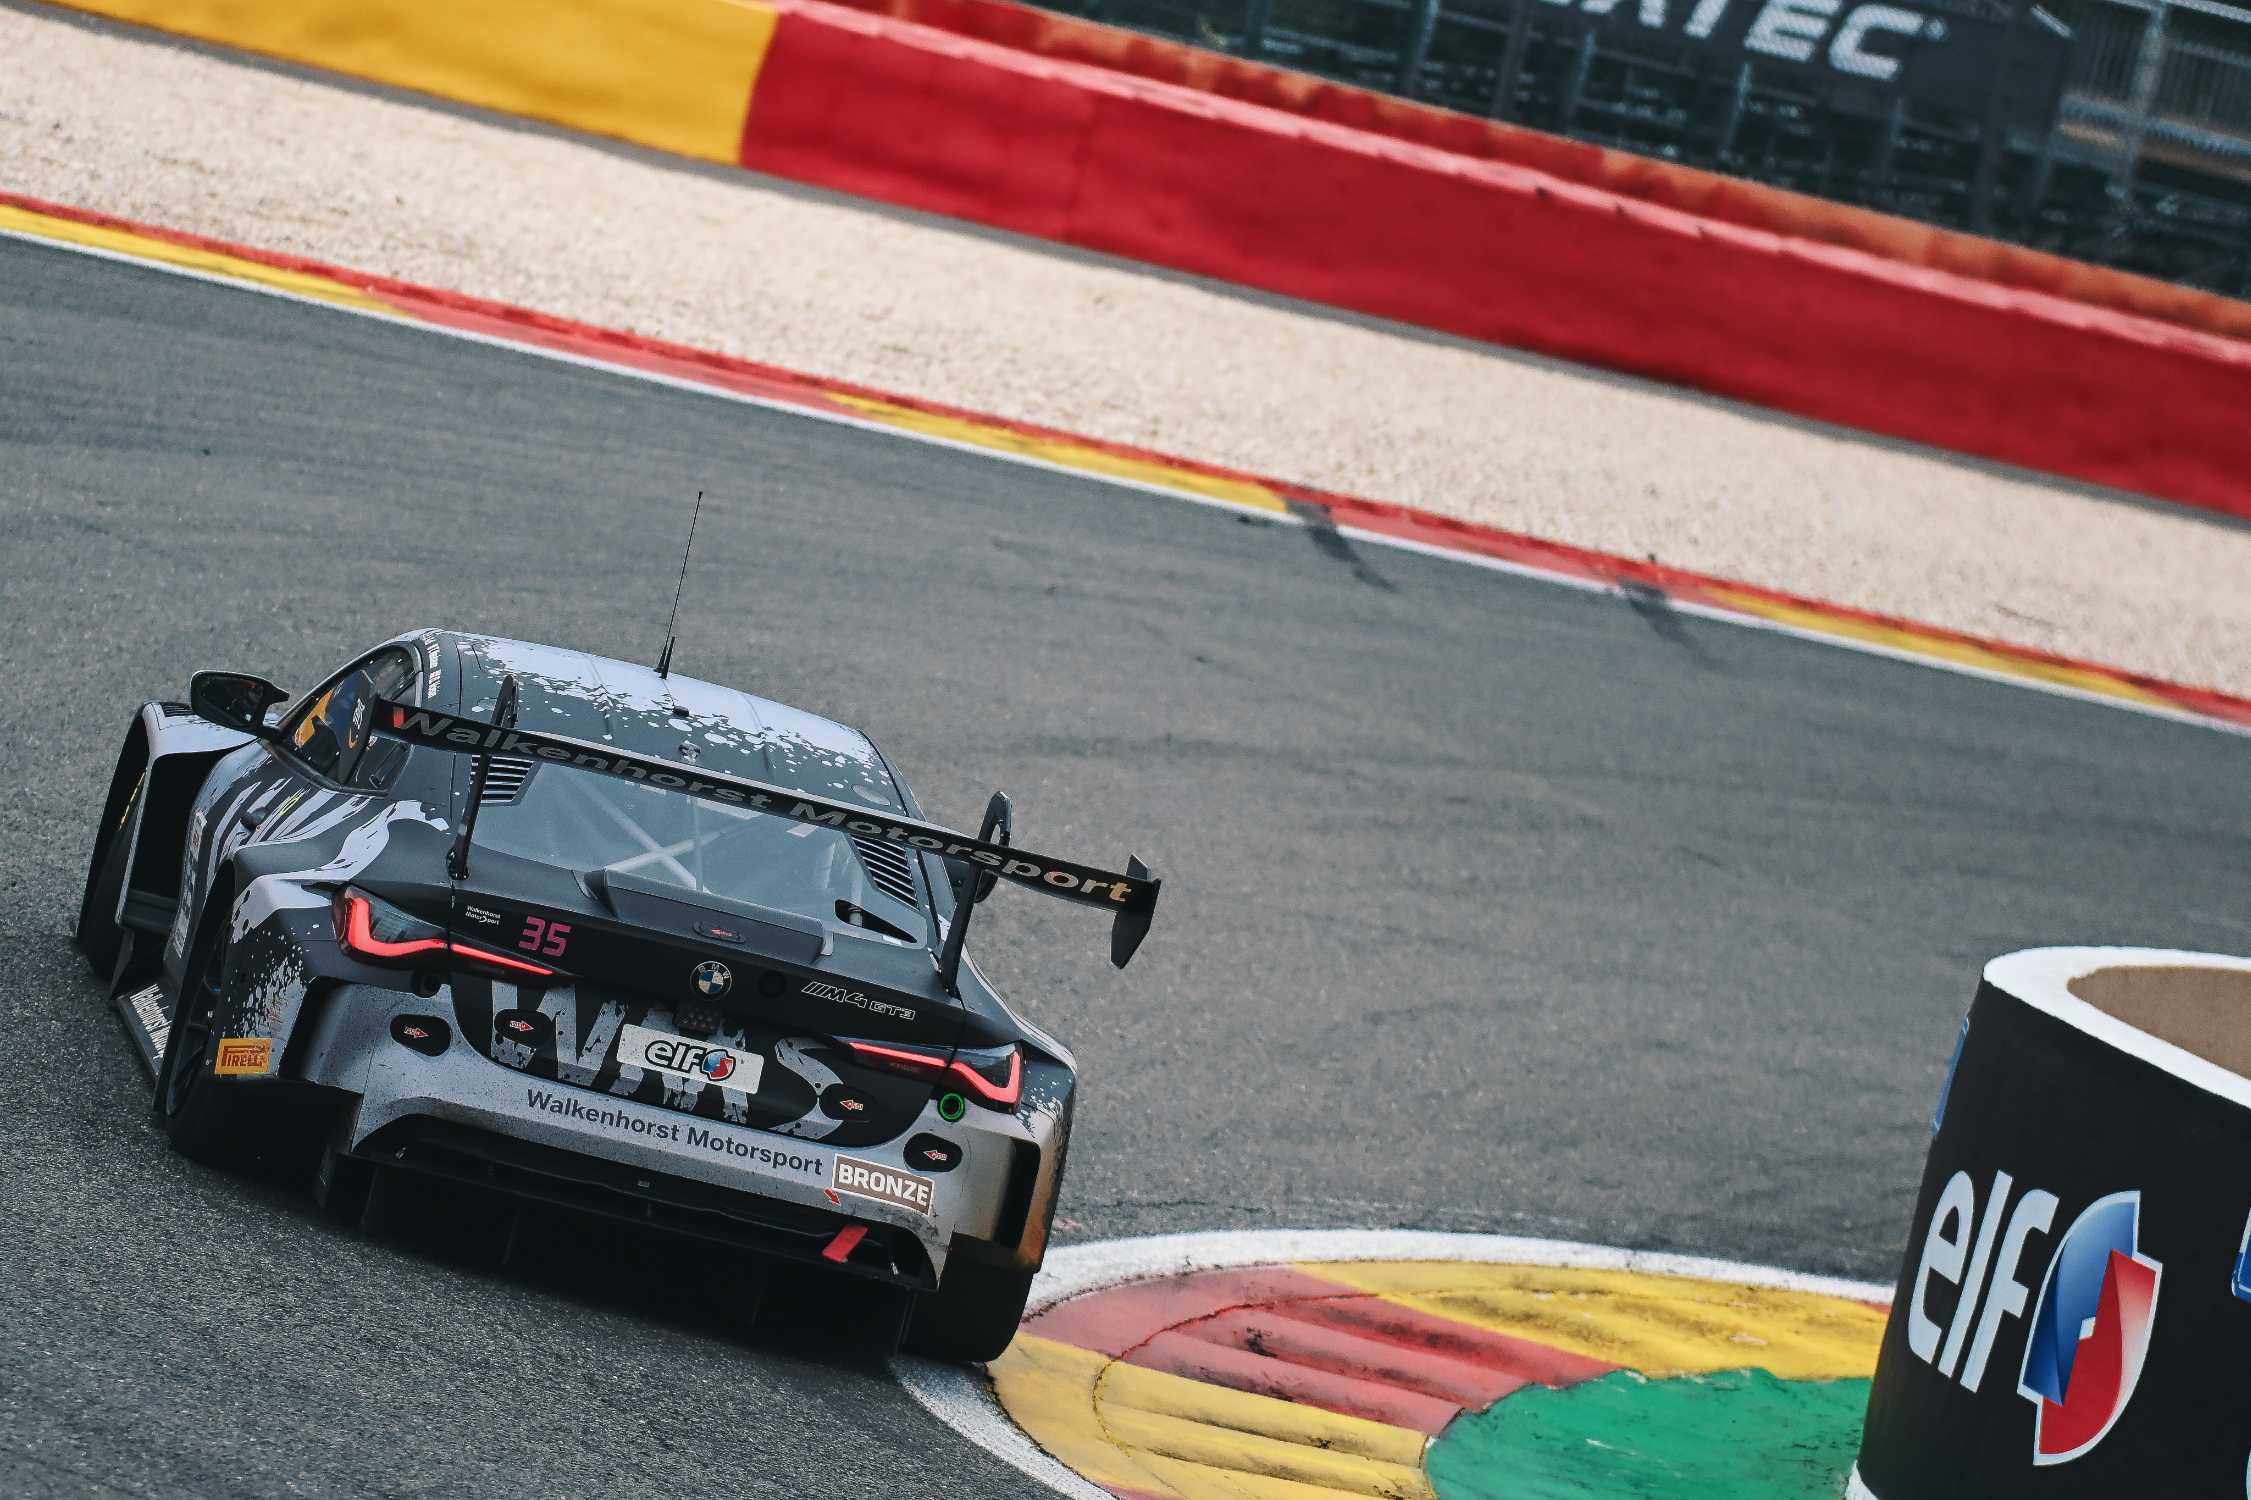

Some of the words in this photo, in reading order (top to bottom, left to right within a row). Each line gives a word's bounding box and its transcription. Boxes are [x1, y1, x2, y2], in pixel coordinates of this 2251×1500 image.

[393, 706, 772, 809] Walkenhorst
[789, 802, 1133, 903] Motorsport
[518, 915, 572, 957] 35
[645, 1038, 709, 1075] elf
[527, 1088, 680, 1142] Walkenhorst
[687, 1126, 824, 1176] Motorsport
[838, 1163, 930, 1207] BRONZE
[1907, 1169, 2060, 1394] elf
